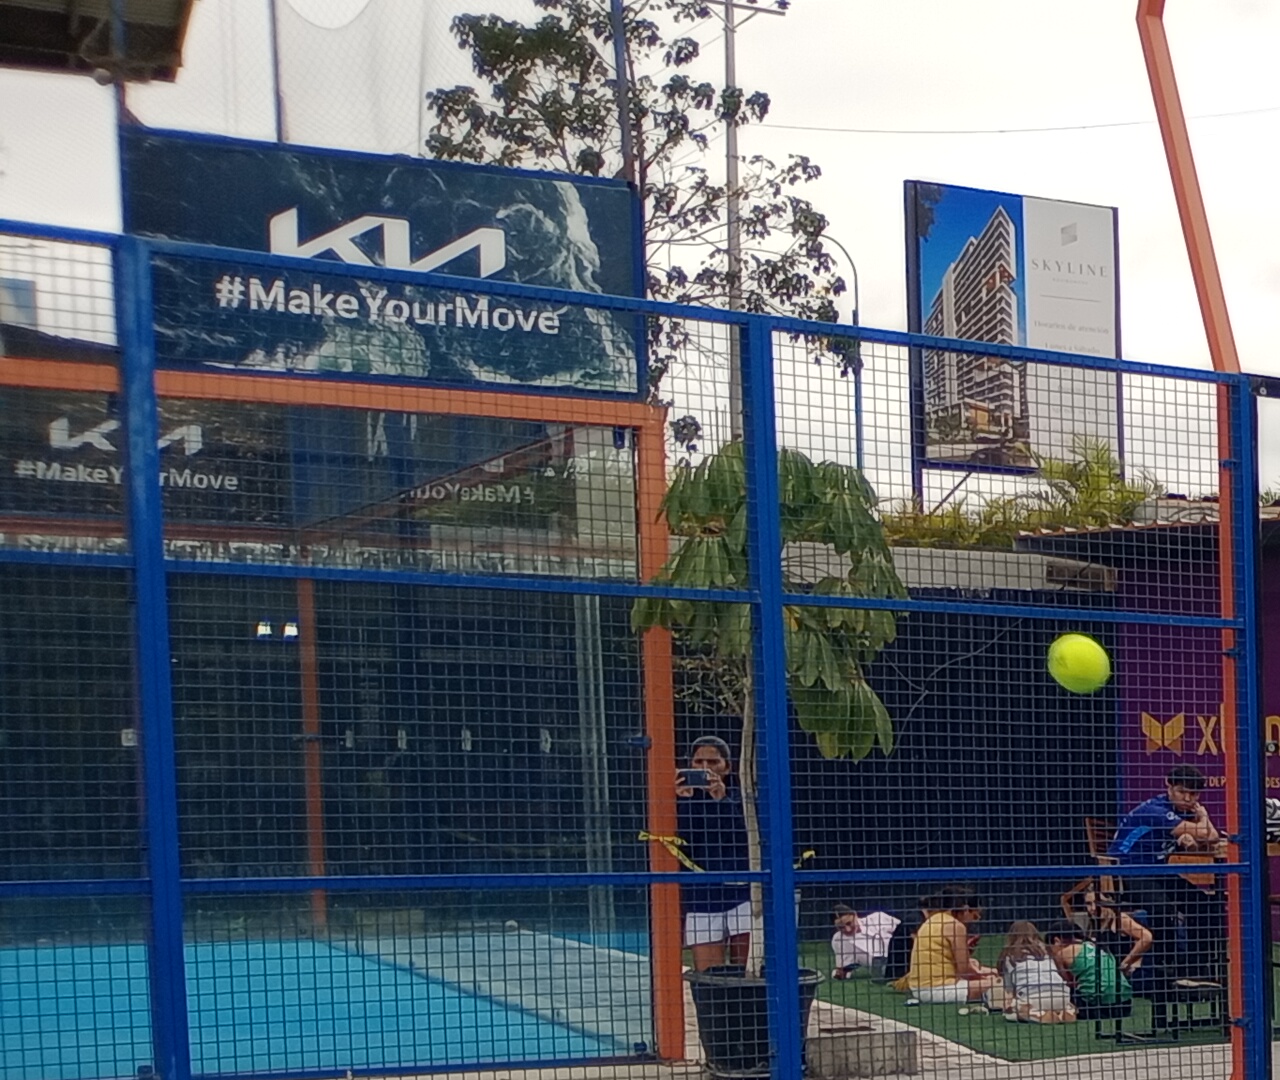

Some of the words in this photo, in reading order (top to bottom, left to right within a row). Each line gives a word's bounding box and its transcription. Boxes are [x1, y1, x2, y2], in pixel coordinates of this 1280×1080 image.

[1031, 259, 1108, 278] SKYLINE
[214, 275, 561, 336] #MakeYourMove
[14, 458, 239, 492] #MakeYrMove
